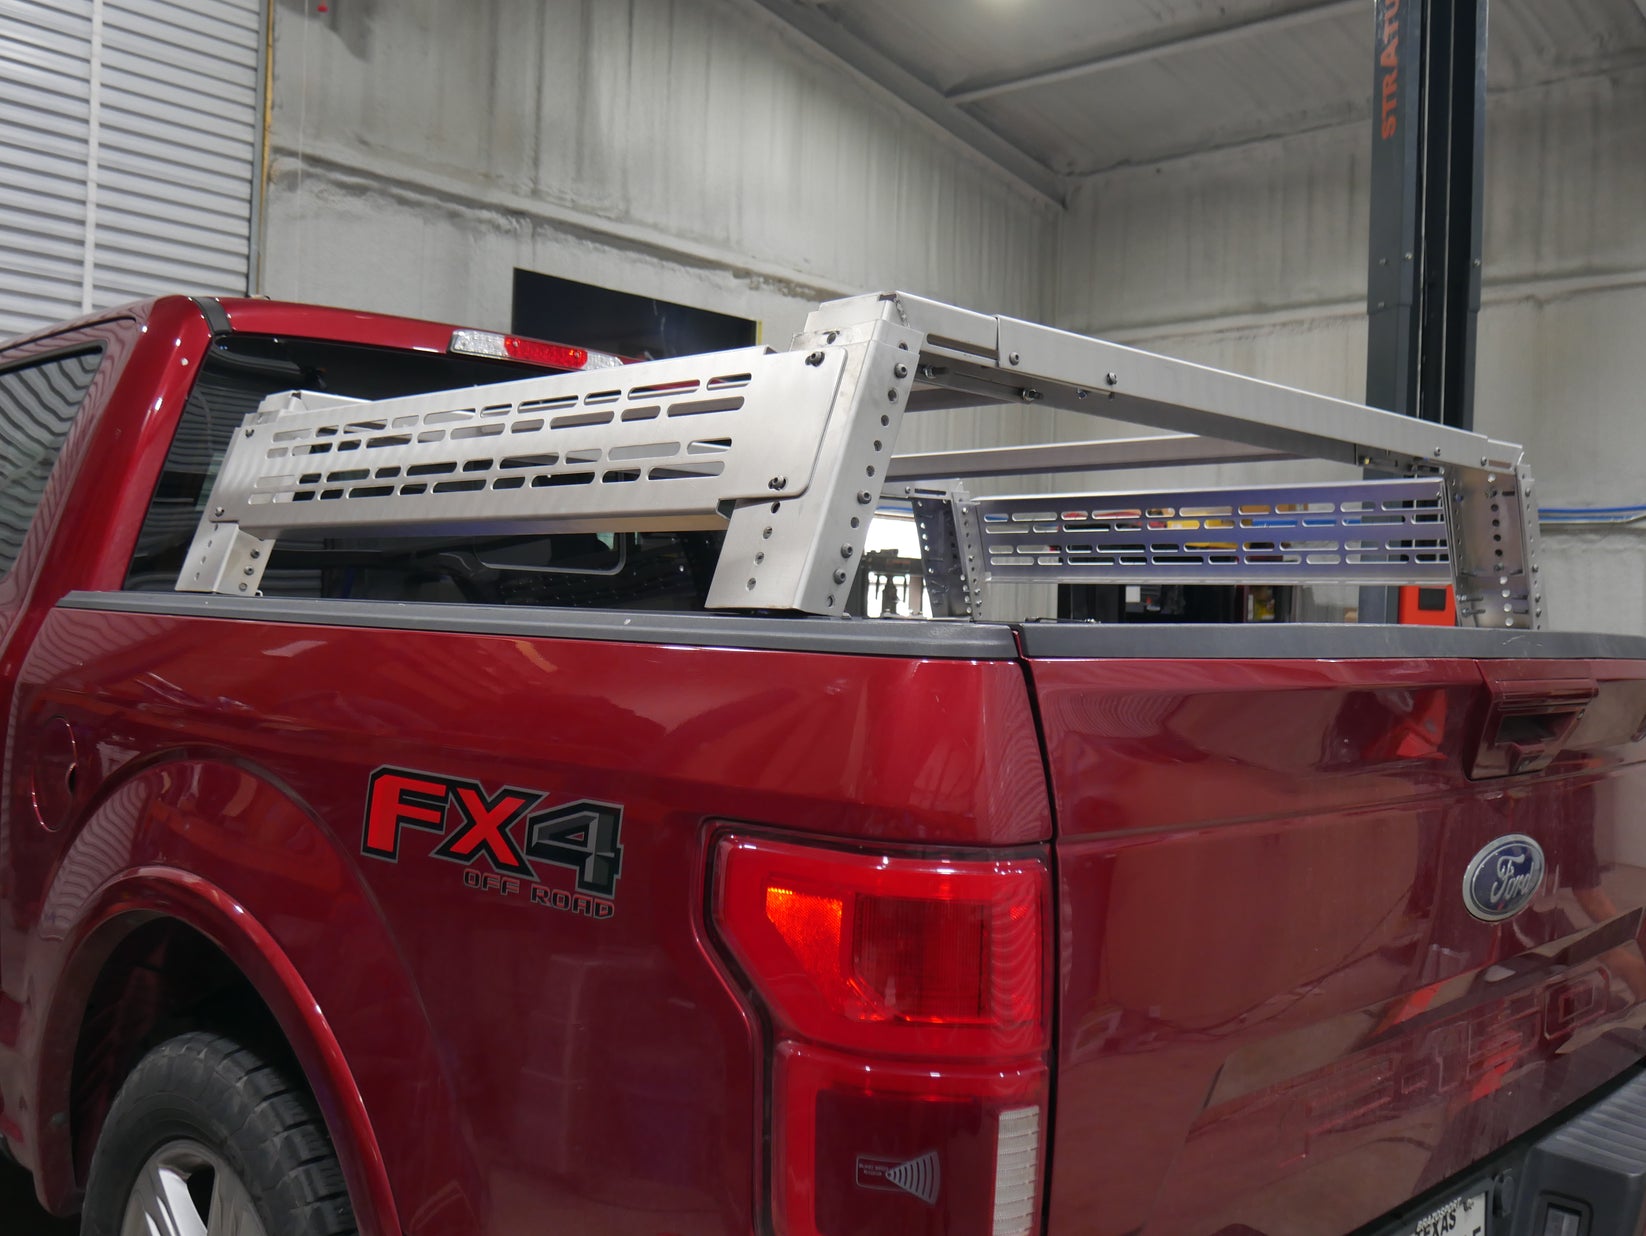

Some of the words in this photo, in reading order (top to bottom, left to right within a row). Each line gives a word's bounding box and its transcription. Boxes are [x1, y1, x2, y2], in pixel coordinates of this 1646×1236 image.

[360, 764, 624, 899] FX4
[463, 868, 520, 895] OFF
[531, 883, 615, 920] ROAD
[1490, 853, 1535, 904] Ford
